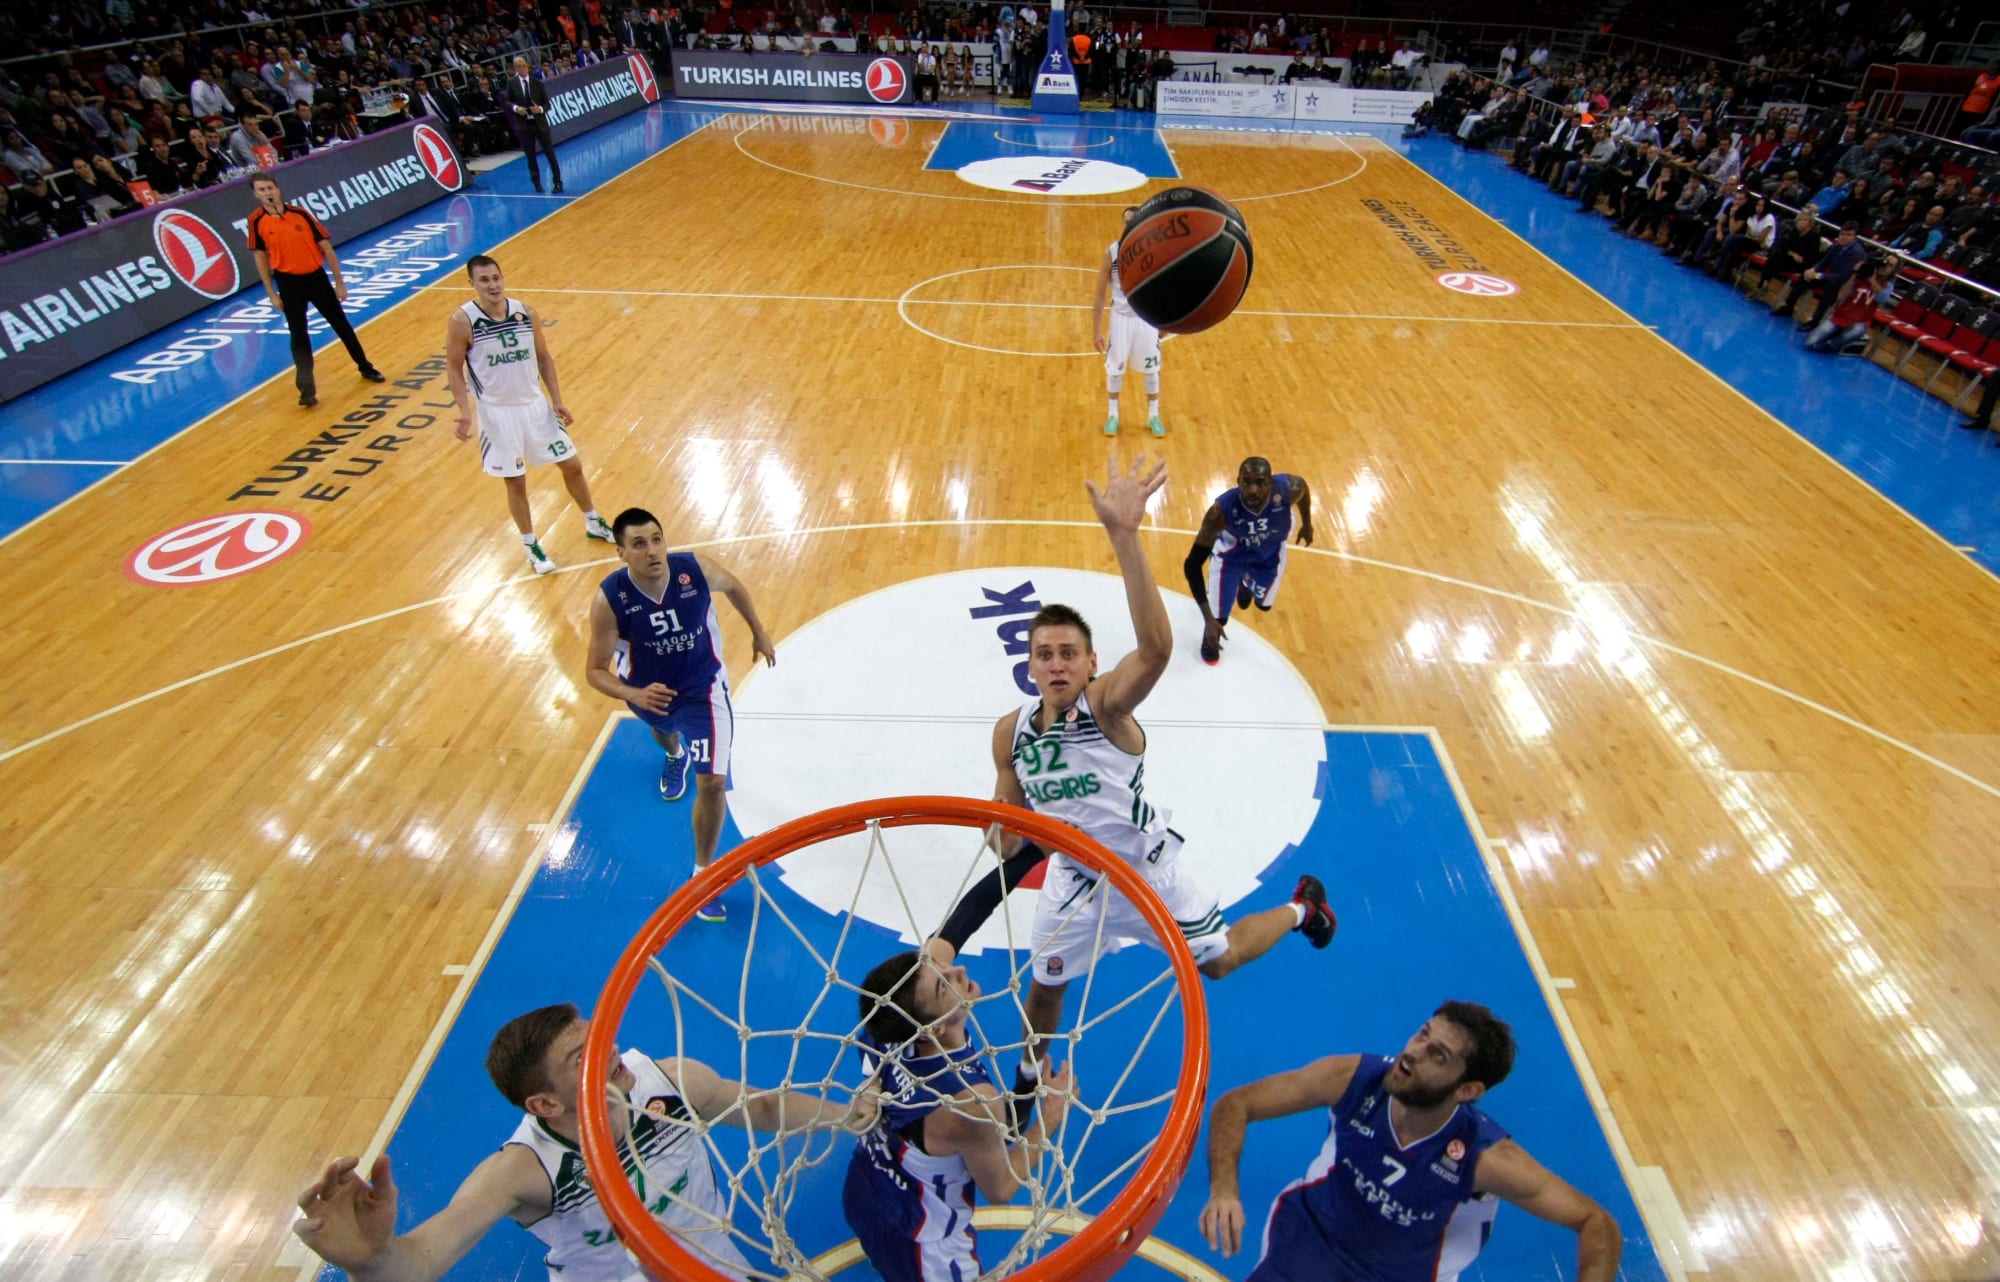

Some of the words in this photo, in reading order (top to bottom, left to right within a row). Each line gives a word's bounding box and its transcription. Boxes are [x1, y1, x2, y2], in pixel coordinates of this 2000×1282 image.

[585, 71, 638, 110] AIRLINES
[680, 67, 768, 86] TURKISH
[773, 69, 863, 88] AIRLINES
[339, 154, 426, 209] AIRLINES
[340, 222, 461, 268] ARENA
[0, 255, 173, 353] AIRLINES
[496, 331, 519, 349] 13
[1144, 356, 1158, 368] 21
[227, 394, 410, 501] TURKISH
[547, 440, 568, 457] 13
[1247, 518, 1269, 535] 13
[650, 608, 684, 636] 51
[691, 738, 710, 764] 51
[1019, 740, 1069, 776] 92
[1024, 772, 1102, 803] ALGIRIS
[1382, 1155, 1407, 1187] 7
